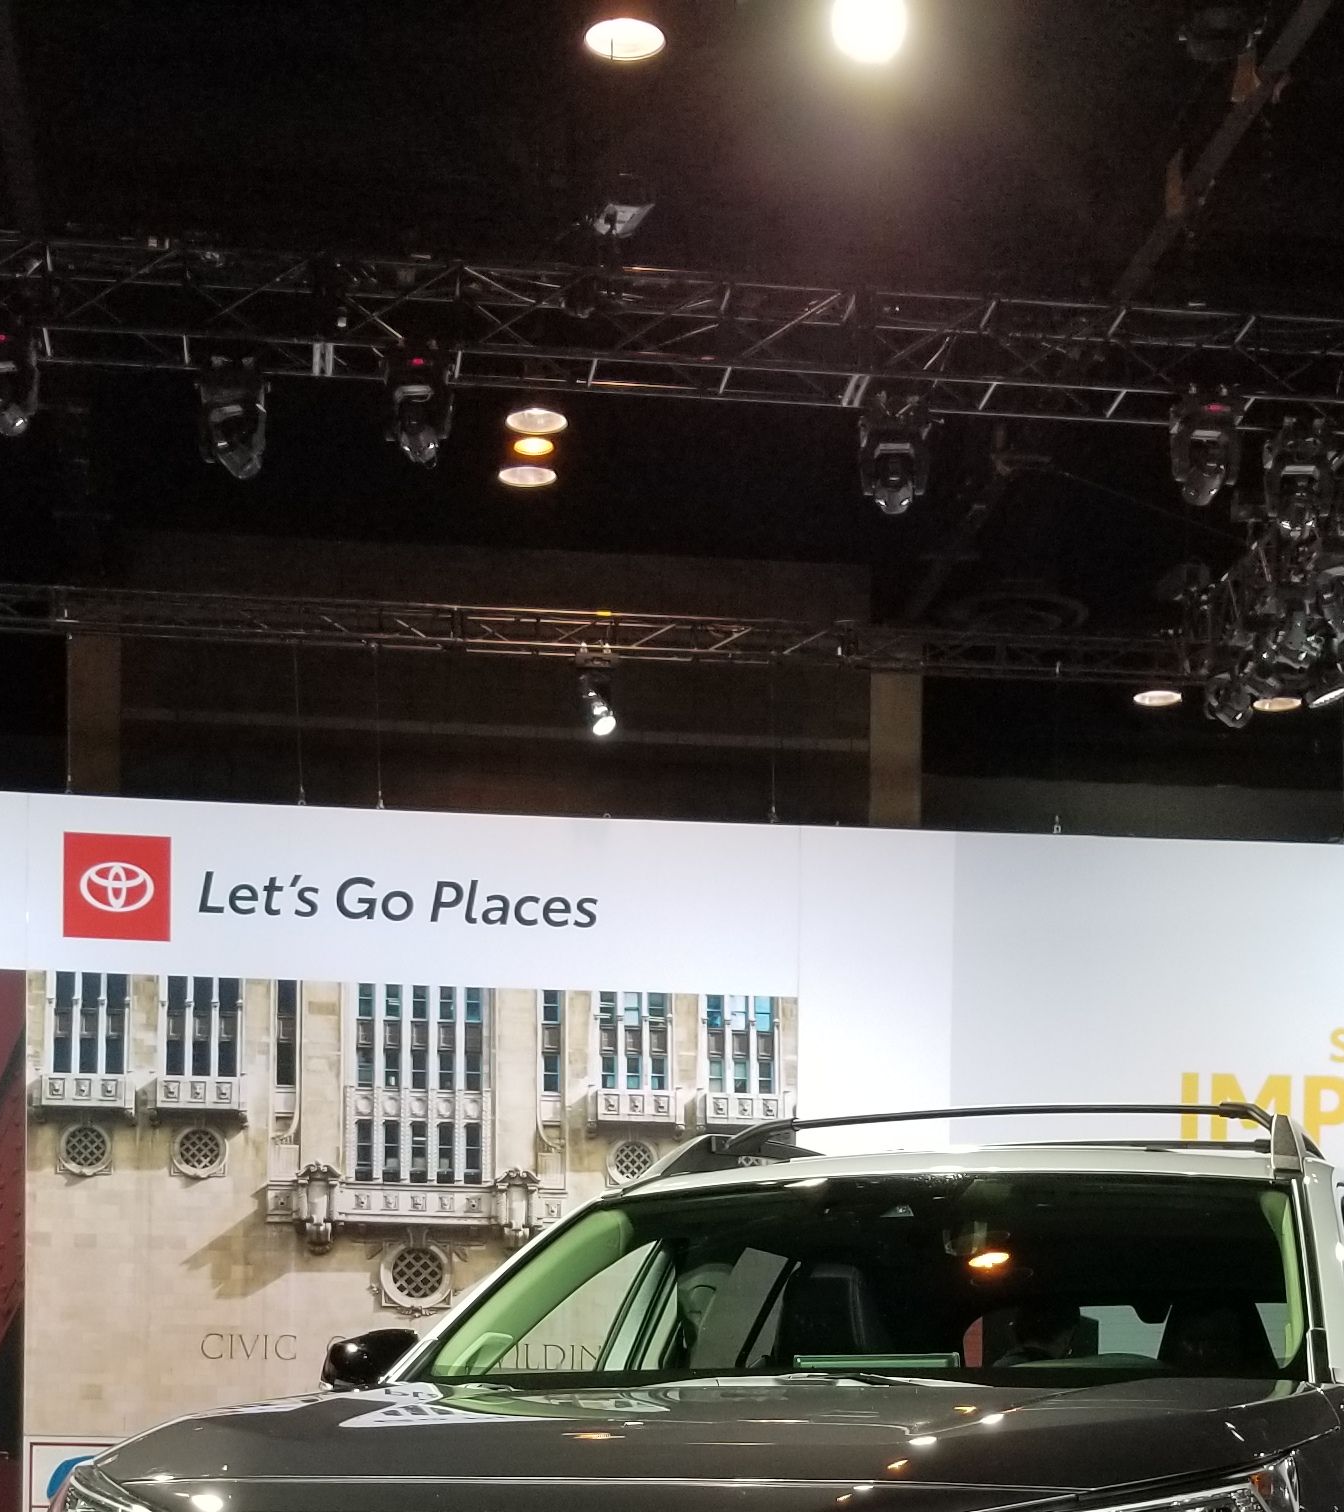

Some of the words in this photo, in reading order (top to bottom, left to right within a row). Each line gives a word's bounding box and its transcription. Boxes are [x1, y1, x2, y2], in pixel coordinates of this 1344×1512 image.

[198, 870, 320, 918] Let's
[335, 876, 415, 922] Go
[429, 879, 599, 929] Places
[200, 1332, 298, 1361] CIVIC
